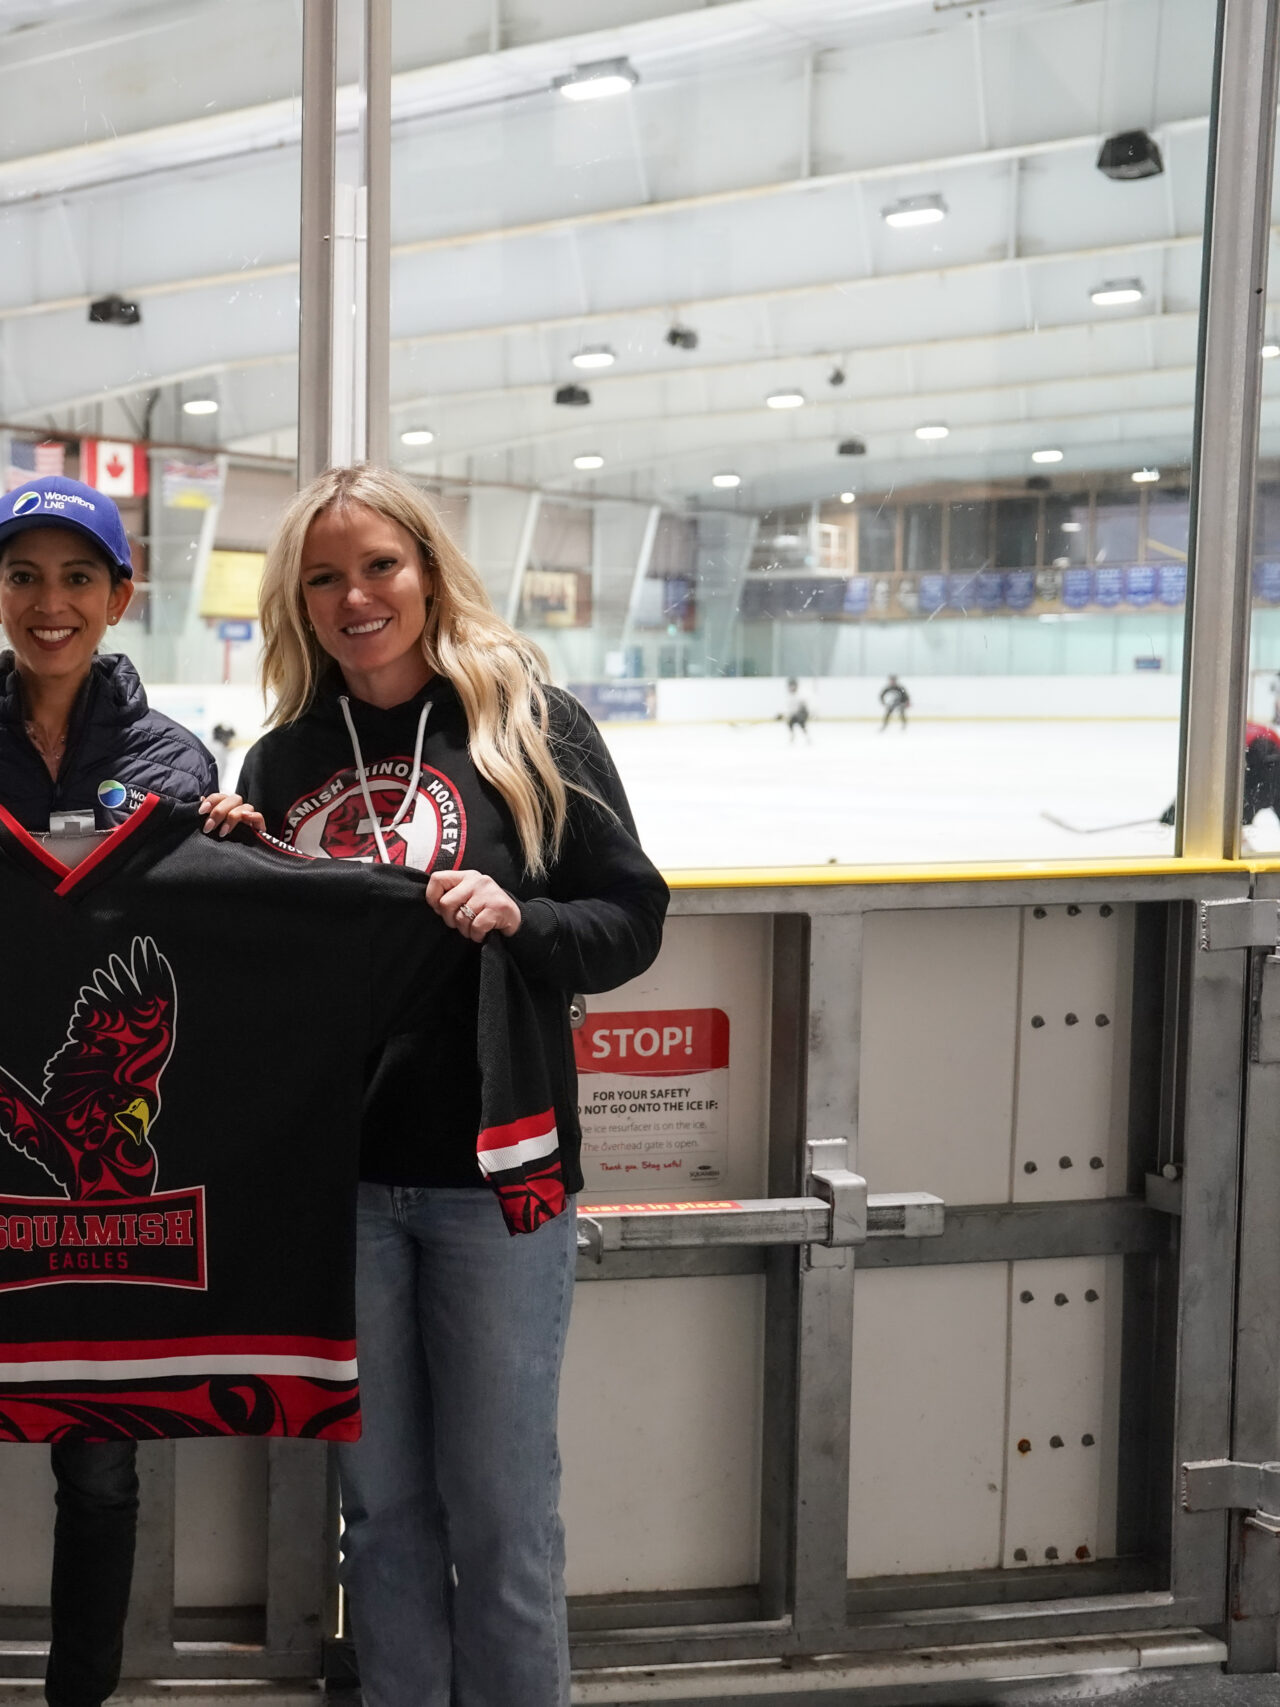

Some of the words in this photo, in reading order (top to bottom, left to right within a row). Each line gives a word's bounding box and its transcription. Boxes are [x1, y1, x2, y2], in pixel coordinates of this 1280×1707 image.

[44, 491, 96, 511] Woodfibre
[44, 501, 65, 509] LNG
[284, 777, 345, 844] UAMISH
[427, 779, 459, 856] HOCKEY
[592, 1026, 693, 1059] STOP!
[592, 1091, 615, 1101] FOR
[617, 1089, 648, 1100] YOUR
[650, 1088, 691, 1099] SAFETY
[584, 1104, 608, 1115] NOT
[610, 1104, 627, 1114] GO
[629, 1102, 661, 1113] ONTO
[663, 1101, 684, 1111] THE
[686, 1100, 703, 1110] ICE
[705, 1099, 718, 1110] IF:
[594, 1122, 607, 1133] ice
[609, 1121, 652, 1133] resurfacer
[654, 1121, 661, 1130] is
[662, 1122, 674, 1130] on
[676, 1120, 691, 1130] the
[583, 1142, 600, 1151] The
[601, 1140, 642, 1151] overhead
[644, 1141, 664, 1152] gate
[666, 1140, 672, 1149] is
[600, 1161, 622, 1171] Thank
[641, 1160, 660, 1171] Stay
[625, 1203, 645, 1211] is
[648, 1202, 671, 1210] in
[674, 1201, 733, 1211] place
[49, 1252, 129, 1270] EAGLES
